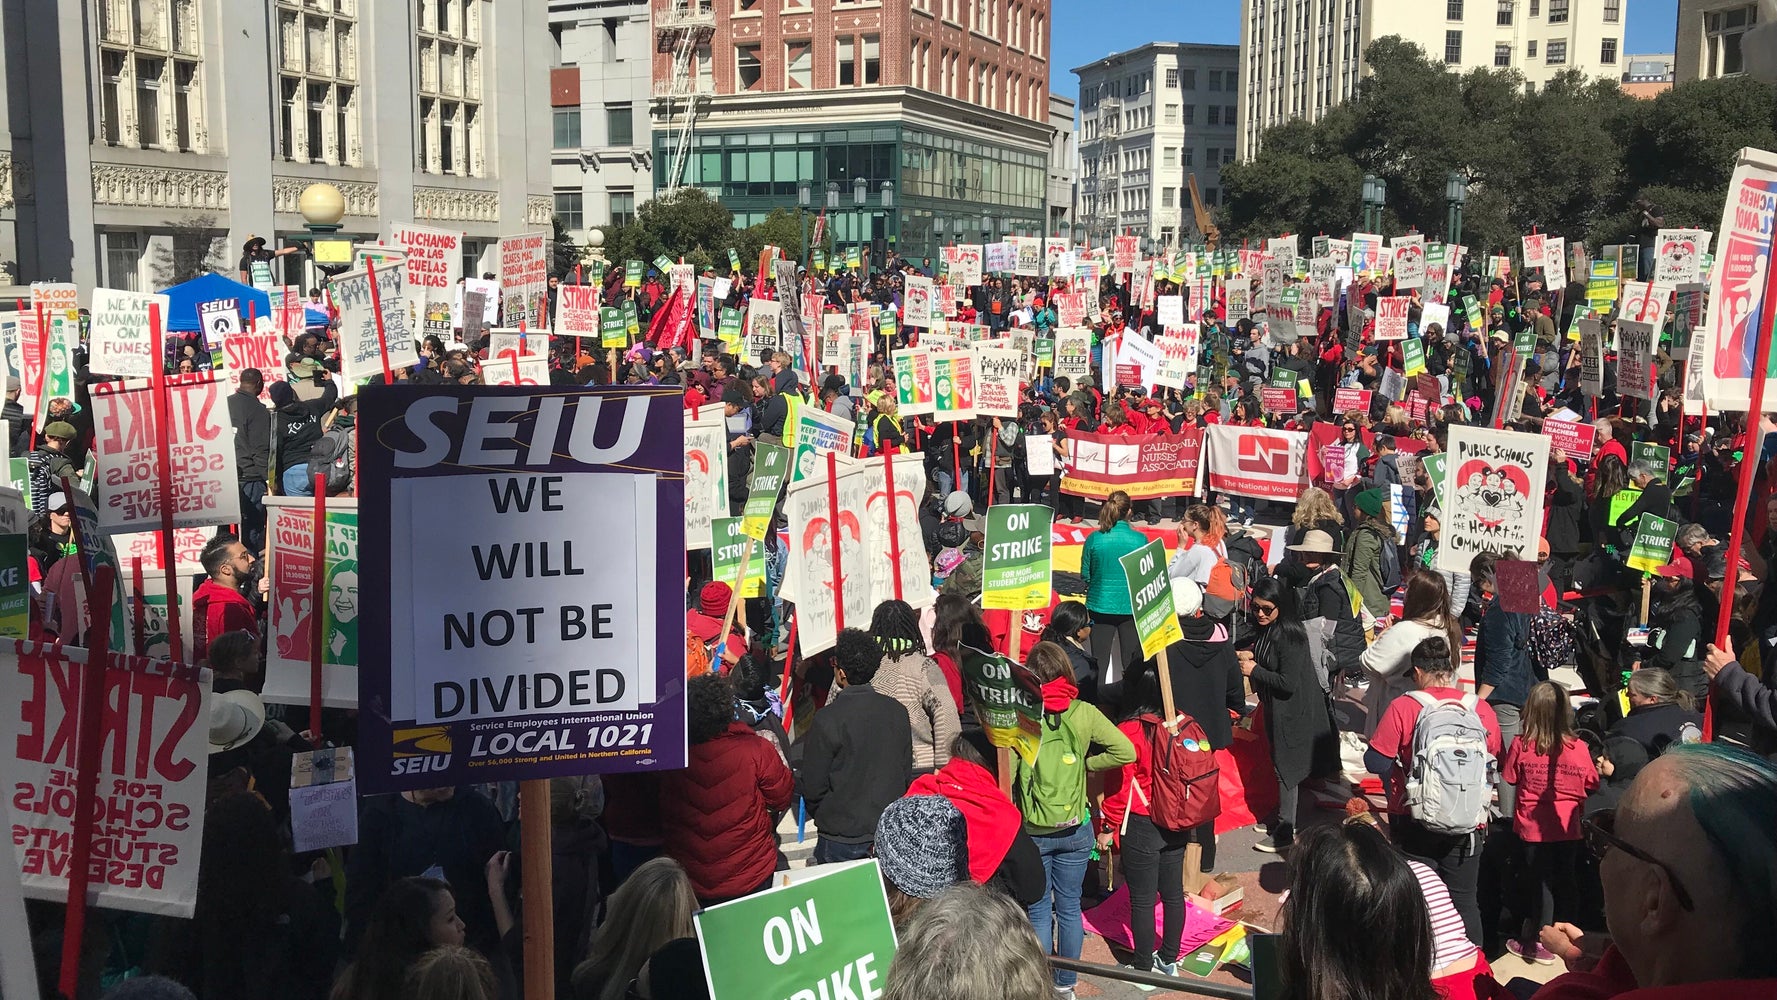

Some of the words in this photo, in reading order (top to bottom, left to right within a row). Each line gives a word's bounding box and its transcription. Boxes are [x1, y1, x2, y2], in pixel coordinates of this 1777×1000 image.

[400, 230, 456, 249] LUCHAMOS
[1115, 238, 1137, 253] STRIKE
[408, 247, 425, 257] POR
[427, 249, 444, 260] LAS
[408, 258, 447, 273] CUELAS
[408, 273, 447, 288] BLICAS
[108, 297, 149, 311] WE'RE
[563, 286, 598, 311] STRIKE
[1060, 293, 1084, 309] STRIKE
[202, 300, 235, 313] SEIU
[1380, 298, 1409, 318] STRIKE
[97, 313, 150, 327] RUNNIN
[507, 312, 526, 322] KEEP
[603, 320, 624, 329] STRIKE
[425, 321, 450, 329] KEEP
[117, 327, 140, 339] ON
[752, 335, 776, 344] KEEP
[104, 341, 151, 355] FUMES
[225, 335, 282, 369] STRIKE
[1408, 342, 1415, 350] ON
[1406, 349, 1421, 360] STRIKE
[1583, 358, 1599, 367] KEEP
[1272, 380, 1292, 388] STRIKE
[394, 396, 651, 468] SEIU
[1545, 427, 1578, 436] TEACHERS
[1546, 421, 1576, 430] WITHOUT
[801, 425, 817, 439] KEEP
[818, 430, 849, 444] TEACHERS
[1555, 434, 1590, 446] WOULDN'T
[801, 435, 809, 443] IN
[811, 437, 849, 454] OAKLAND!
[1143, 439, 1199, 453] CALIFORNIA
[1552, 441, 1577, 449] NURSES
[1643, 447, 1655, 457] ON
[765, 451, 778, 467] ON
[1142, 452, 1178, 463] NURSES
[1459, 441, 1492, 460] PUBLIC
[1493, 445, 1534, 468] SCHOOLS
[1141, 459, 1198, 473] ASSOCIATIO
[752, 475, 780, 492] STRIKE
[1239, 482, 1270, 492] National
[1272, 485, 1294, 493] Voice
[488, 476, 563, 513] WE
[1007, 512, 1030, 531] ON
[1651, 520, 1664, 531] ON
[727, 522, 742, 537] ON
[991, 536, 1042, 561] STRIKE
[1639, 534, 1671, 548] STRIKE
[718, 541, 758, 561] STRIE
[471, 541, 584, 580] WILL
[1139, 551, 1154, 576] ON
[988, 576, 1017, 587] STUDENT
[1019, 571, 1044, 585] SUPPORT
[1002, 570, 1014, 579] FOR
[1016, 567, 1032, 577] MORE
[1136, 570, 1167, 611] STRIKE
[1, 598, 25, 610] WAGE
[443, 607, 544, 650] NOT
[560, 604, 614, 641] BE
[982, 662, 1012, 680] ON
[433, 668, 626, 719] DIVIDED
[978, 684, 1033, 708] TRIKE
[470, 722, 504, 731] Service
[507, 717, 558, 730] Employees
[561, 714, 623, 726] International
[625, 712, 654, 721] Union
[470, 729, 575, 757] LOCAL
[587, 723, 653, 749] 1021
[514, 756, 538, 764] Strong
[555, 753, 578, 761] United
[588, 750, 619, 758] Northern
[620, 748, 652, 756] California
[391, 754, 451, 776] SEIU
[763, 898, 823, 965] ON
[783, 952, 883, 1000] IKE
